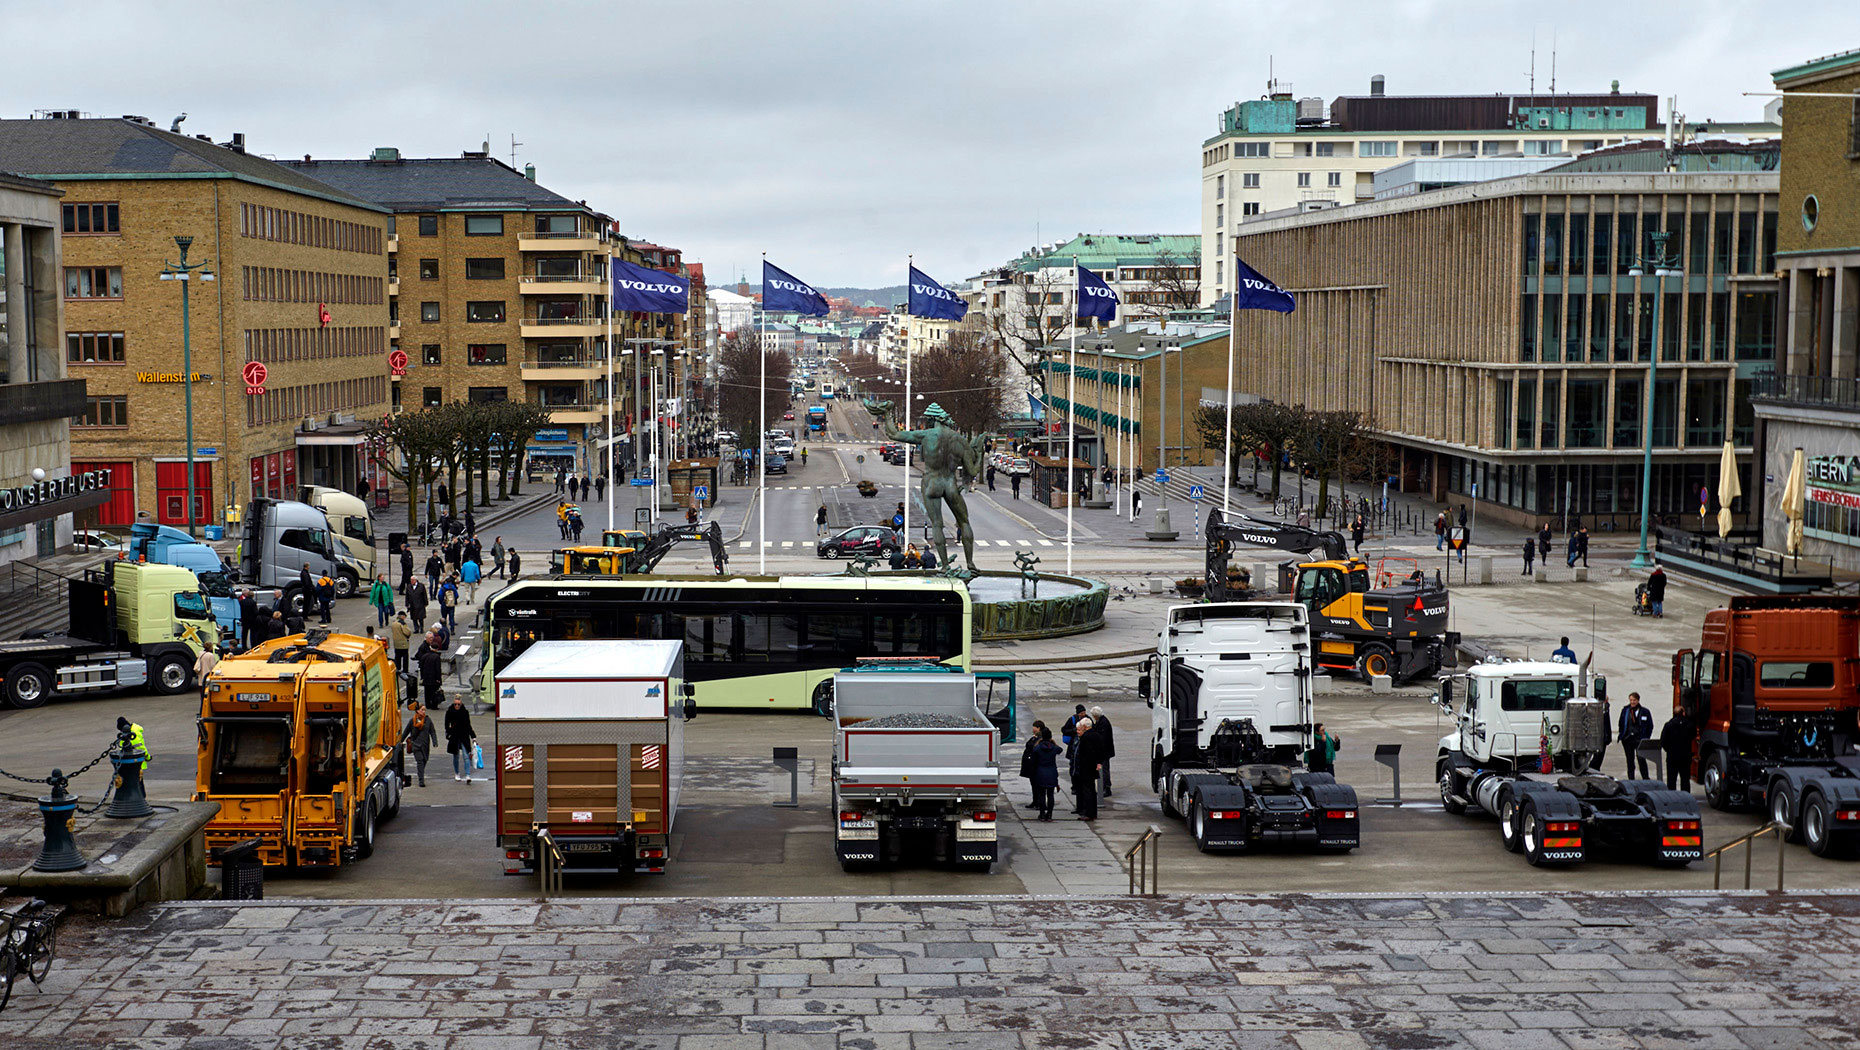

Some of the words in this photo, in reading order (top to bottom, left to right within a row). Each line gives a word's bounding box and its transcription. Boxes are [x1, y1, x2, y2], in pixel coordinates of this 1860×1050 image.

[618, 279, 683, 294] VOLVO
[768, 279, 816, 296] VOLV
[1084, 286, 1116, 300] VOL
[4, 469, 112, 509] ONSERTHUSET
[1242, 533, 1277, 545] VOLVO
[1423, 606, 1447, 616] VOLVO
[1543, 851, 1582, 859] VOLVO
[1662, 850, 1700, 858] VOLVO
